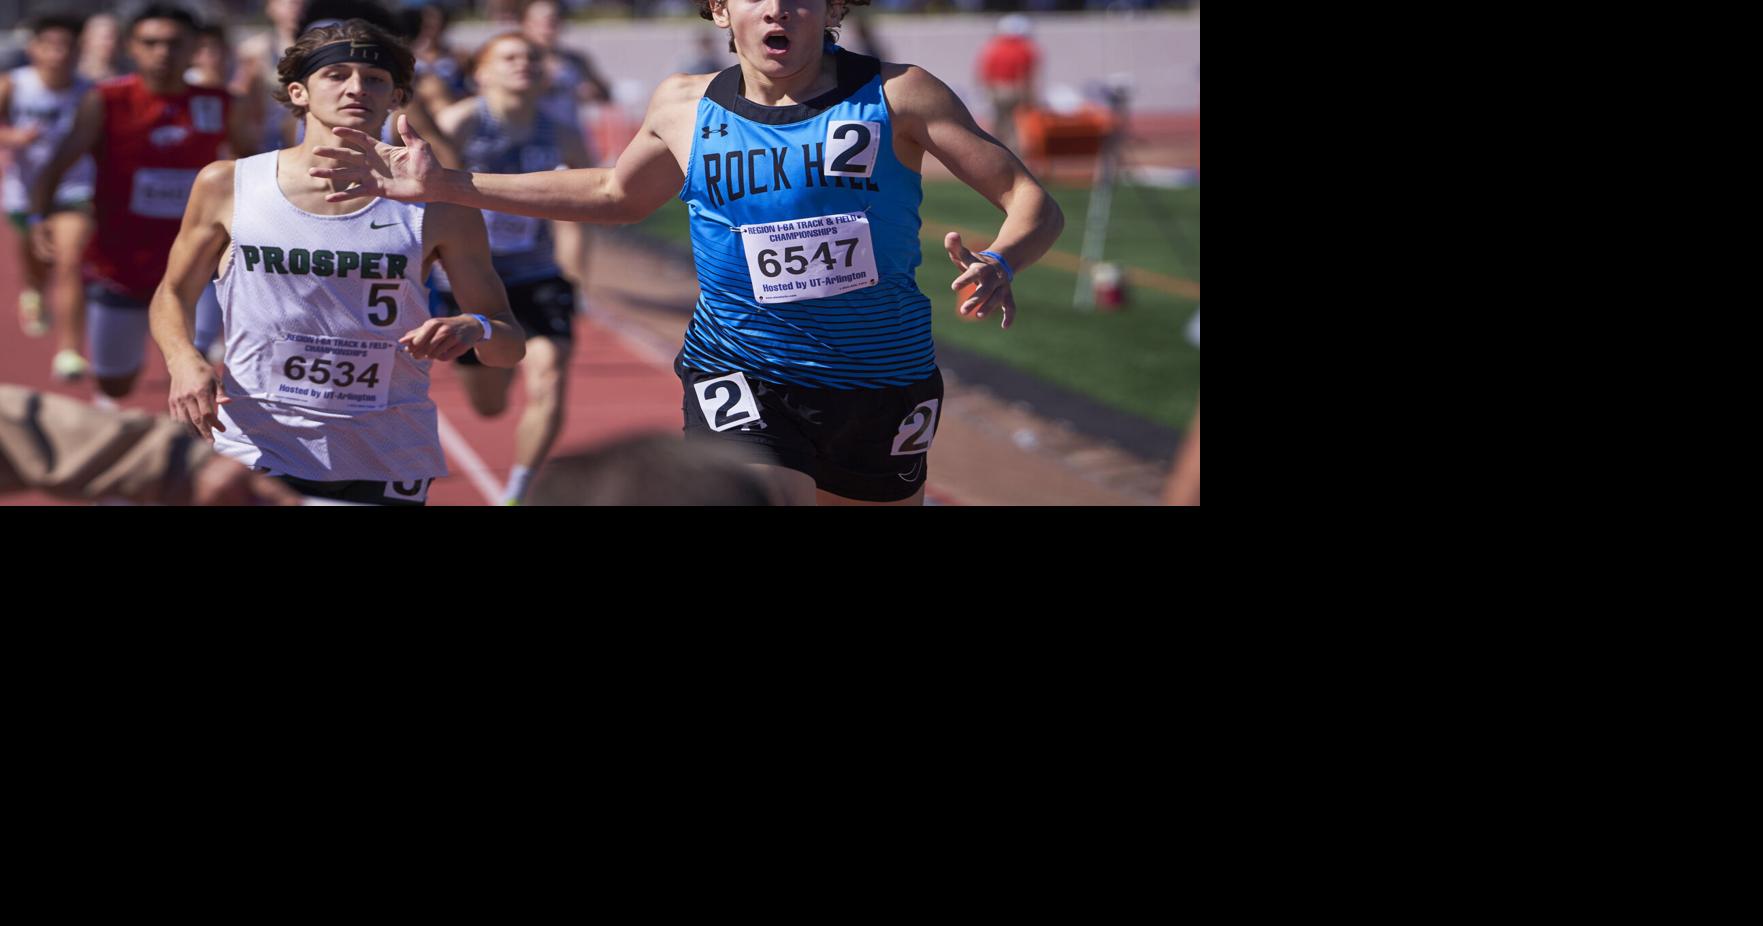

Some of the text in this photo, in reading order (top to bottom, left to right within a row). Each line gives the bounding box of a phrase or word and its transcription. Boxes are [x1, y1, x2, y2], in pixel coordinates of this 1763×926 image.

[831, 123, 871, 173] 2
[703, 146, 792, 209] ROCK
[748, 214, 857, 235] REGION I-6A TRACK & FIELD
[769, 226, 838, 243] CHAMPIONSHIPS
[240, 245, 408, 279] PROSPER
[757, 237, 859, 278] 6547
[763, 281, 792, 292] Hosted
[795, 280, 807, 290] by
[809, 271, 867, 288] UT-Arlington
[367, 283, 400, 327] 5
[334, 337, 358, 349] TRACK
[369, 341, 388, 350] FIELD
[283, 355, 379, 388] 6534
[279, 383, 308, 396] Hosted
[311, 387, 321, 399] by
[704, 379, 750, 428] 2
[898, 406, 933, 453] 2
